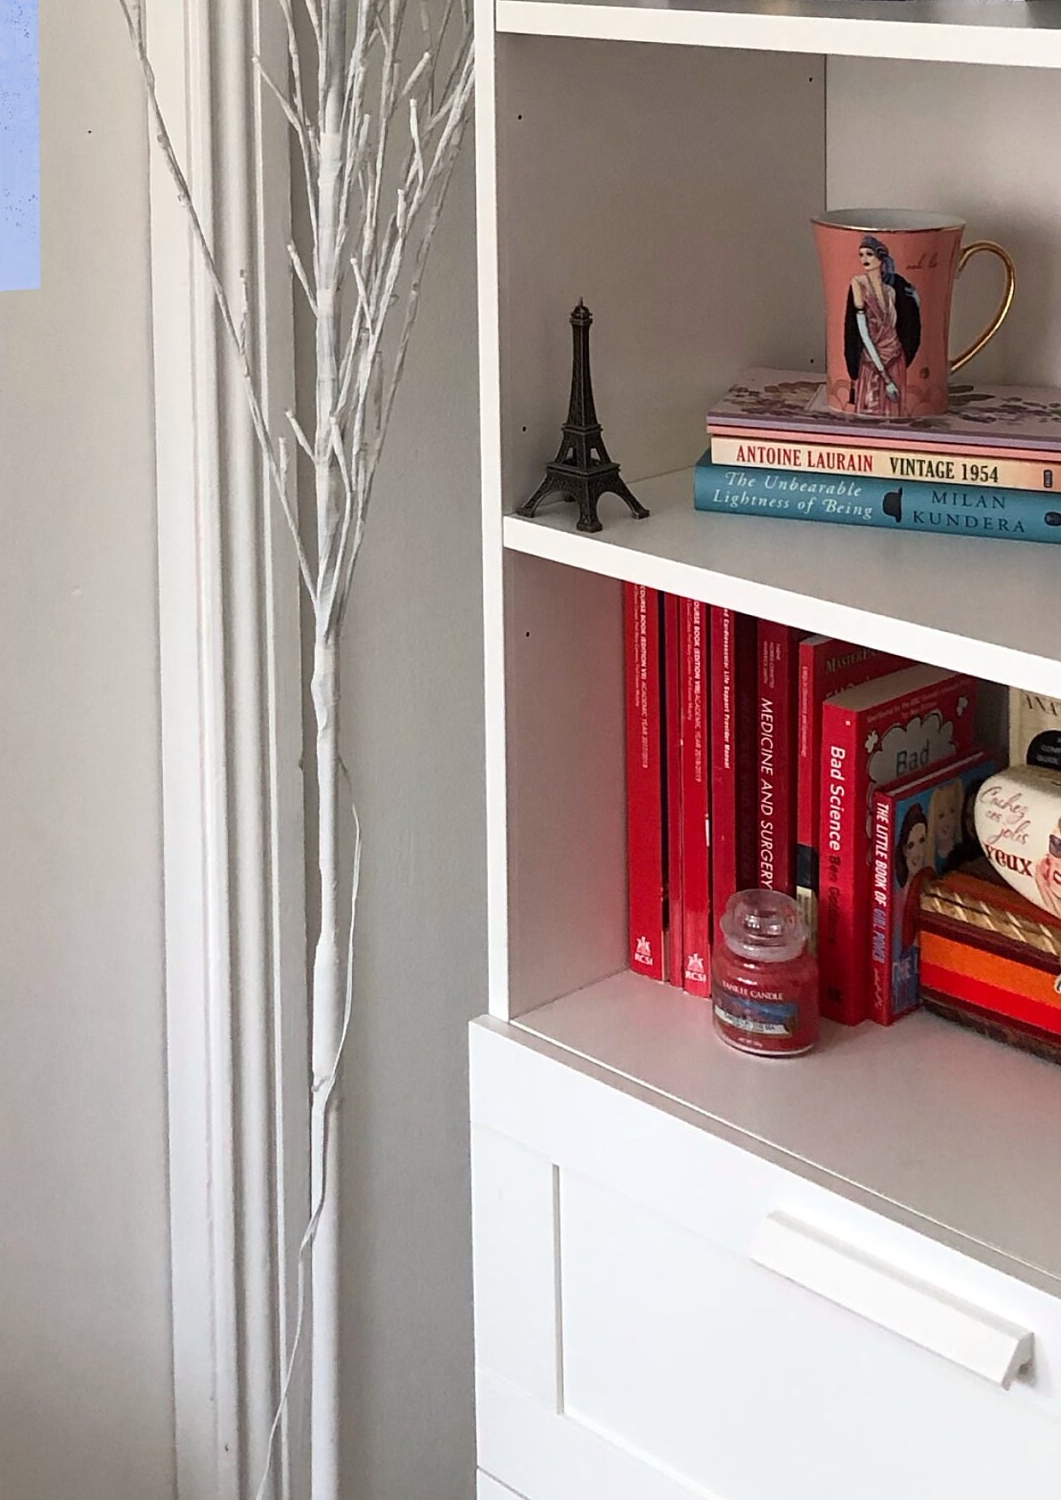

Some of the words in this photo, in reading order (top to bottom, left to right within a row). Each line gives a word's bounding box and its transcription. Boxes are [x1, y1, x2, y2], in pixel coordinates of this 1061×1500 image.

[737, 445, 802, 467] ANTOINE
[808, 450, 874, 473] LAURAIN
[889, 456, 955, 480] VINTAGE
[962, 463, 999, 484] 1954
[725, 471, 756, 488] The
[764, 474, 862, 498] Unbearable
[712, 488, 790, 510] Lightness
[797, 496, 818, 515] of
[821, 497, 874, 521] Being
[931, 490, 1007, 510] MILAN
[913, 510, 1026, 533] KUNDERA
[723, 617, 731, 672] Cardiovascular
[723, 687, 731, 713] Support
[723, 714, 731, 743] Provider
[760, 697, 774, 777] MEDICINE
[723, 744, 731, 769] Manual
[830, 745, 846, 781] Bad
[896, 739, 930, 776] Bad
[760, 778, 774, 817] AND
[829, 784, 845, 851] Science
[876, 802, 889, 824] THE
[876, 823, 889, 860] LITTLE
[988, 820, 1031, 845] jolis
[760, 820, 774, 890] SURGERY
[828, 855, 841, 883] Ben
[874, 859, 888, 891] BOOK
[874, 890, 887, 908] OF
[873, 907, 886, 930] GIRL
[635, 952, 653, 966] RCSI
[872, 930, 886, 964] POWER
[685, 970, 707, 983] RCSI
[749, 990, 784, 1001] CANDLE
